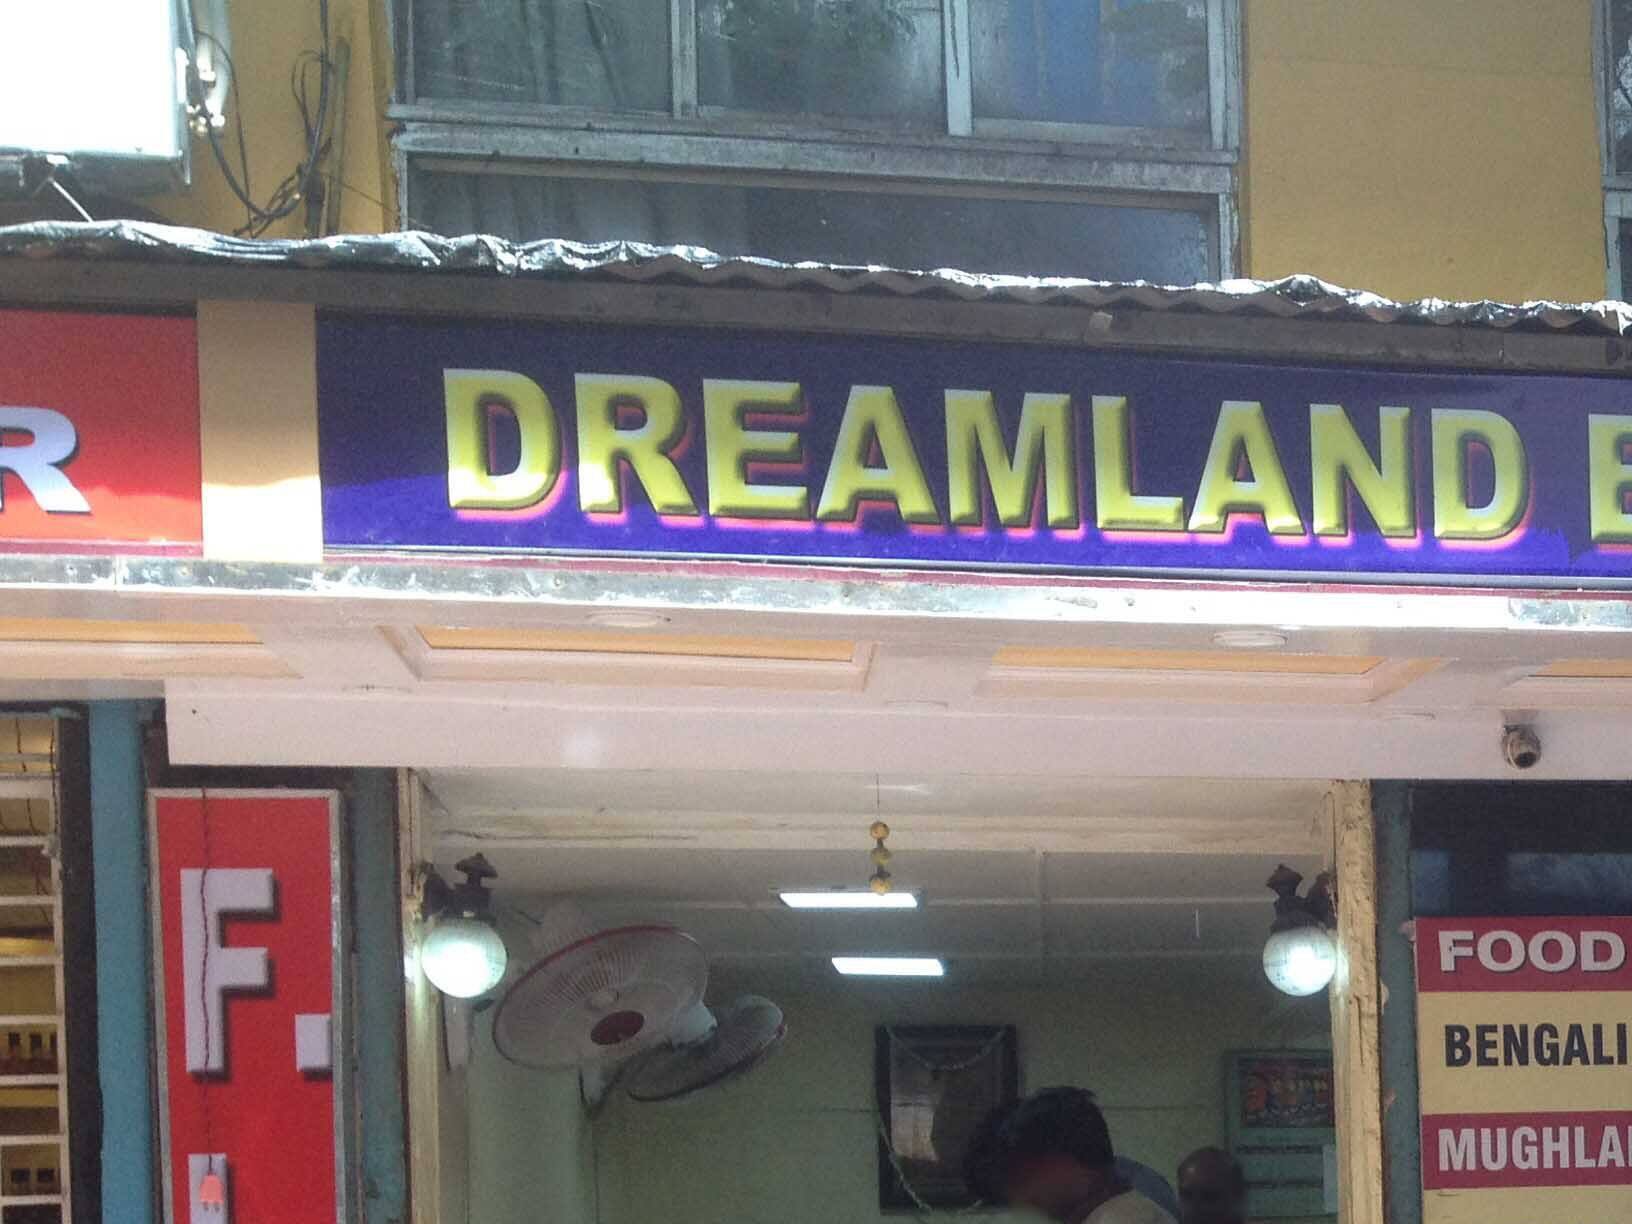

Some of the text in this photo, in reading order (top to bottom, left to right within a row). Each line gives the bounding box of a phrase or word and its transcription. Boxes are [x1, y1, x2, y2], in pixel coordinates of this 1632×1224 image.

[442, 367, 1533, 547] DREAMLAND
[1438, 929, 1627, 974] FOOD
[1444, 1022, 1628, 1068] BENGALI
